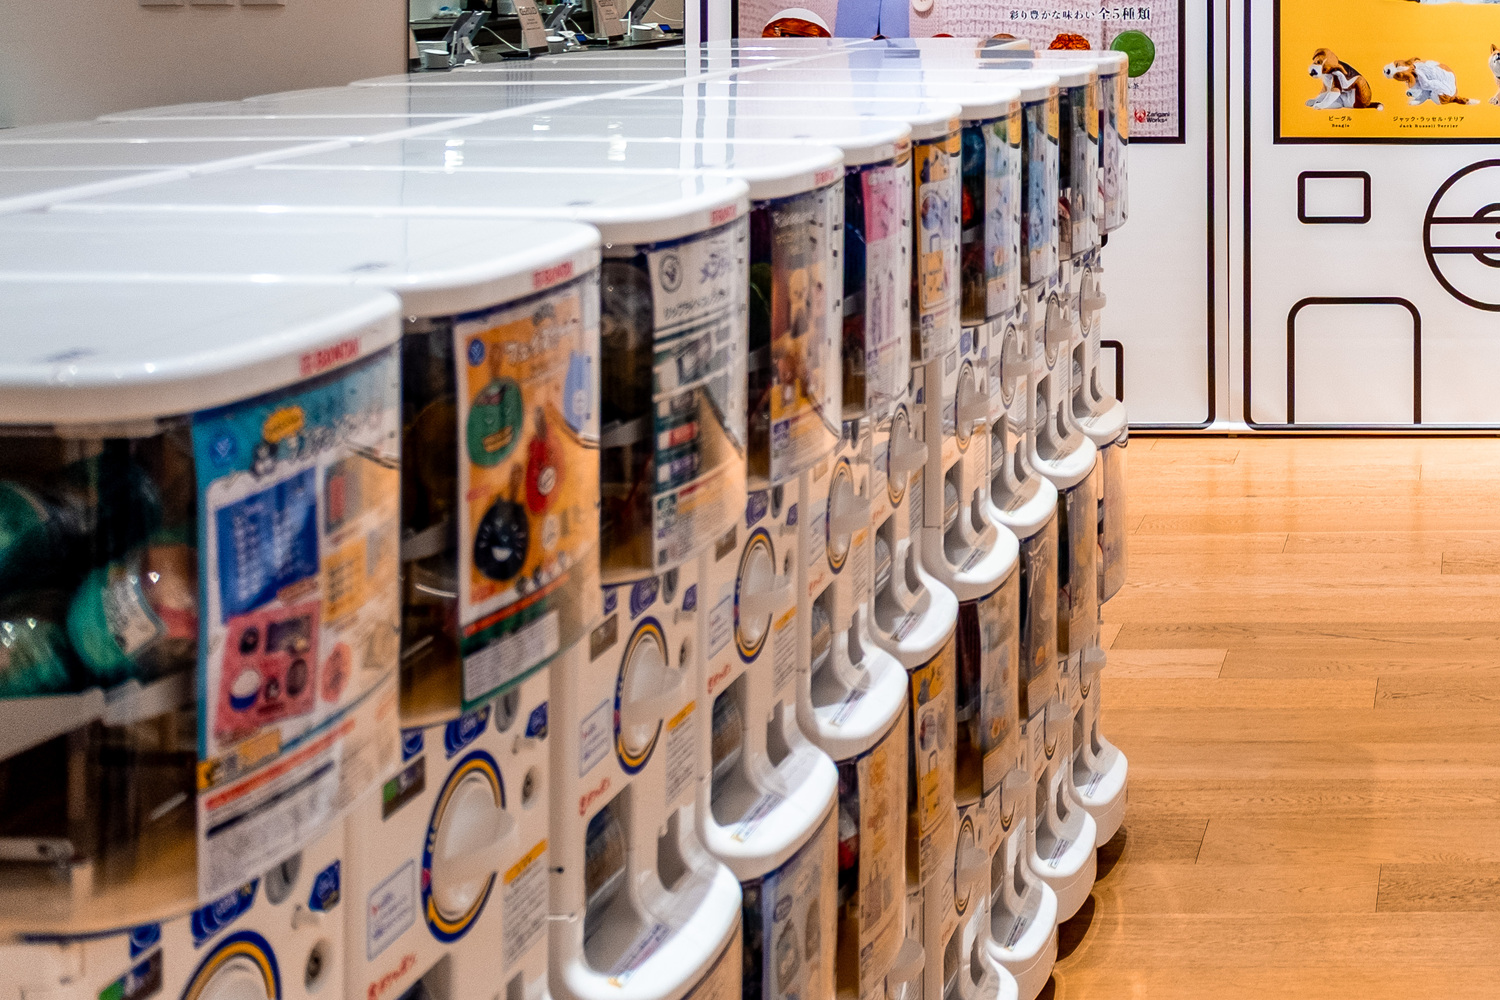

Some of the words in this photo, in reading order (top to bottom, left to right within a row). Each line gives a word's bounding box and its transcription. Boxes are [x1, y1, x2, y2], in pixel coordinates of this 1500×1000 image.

[1010, 9, 1095, 21] 彩り豊かな味わい
[1099, 6, 1151, 21] 全5種類
